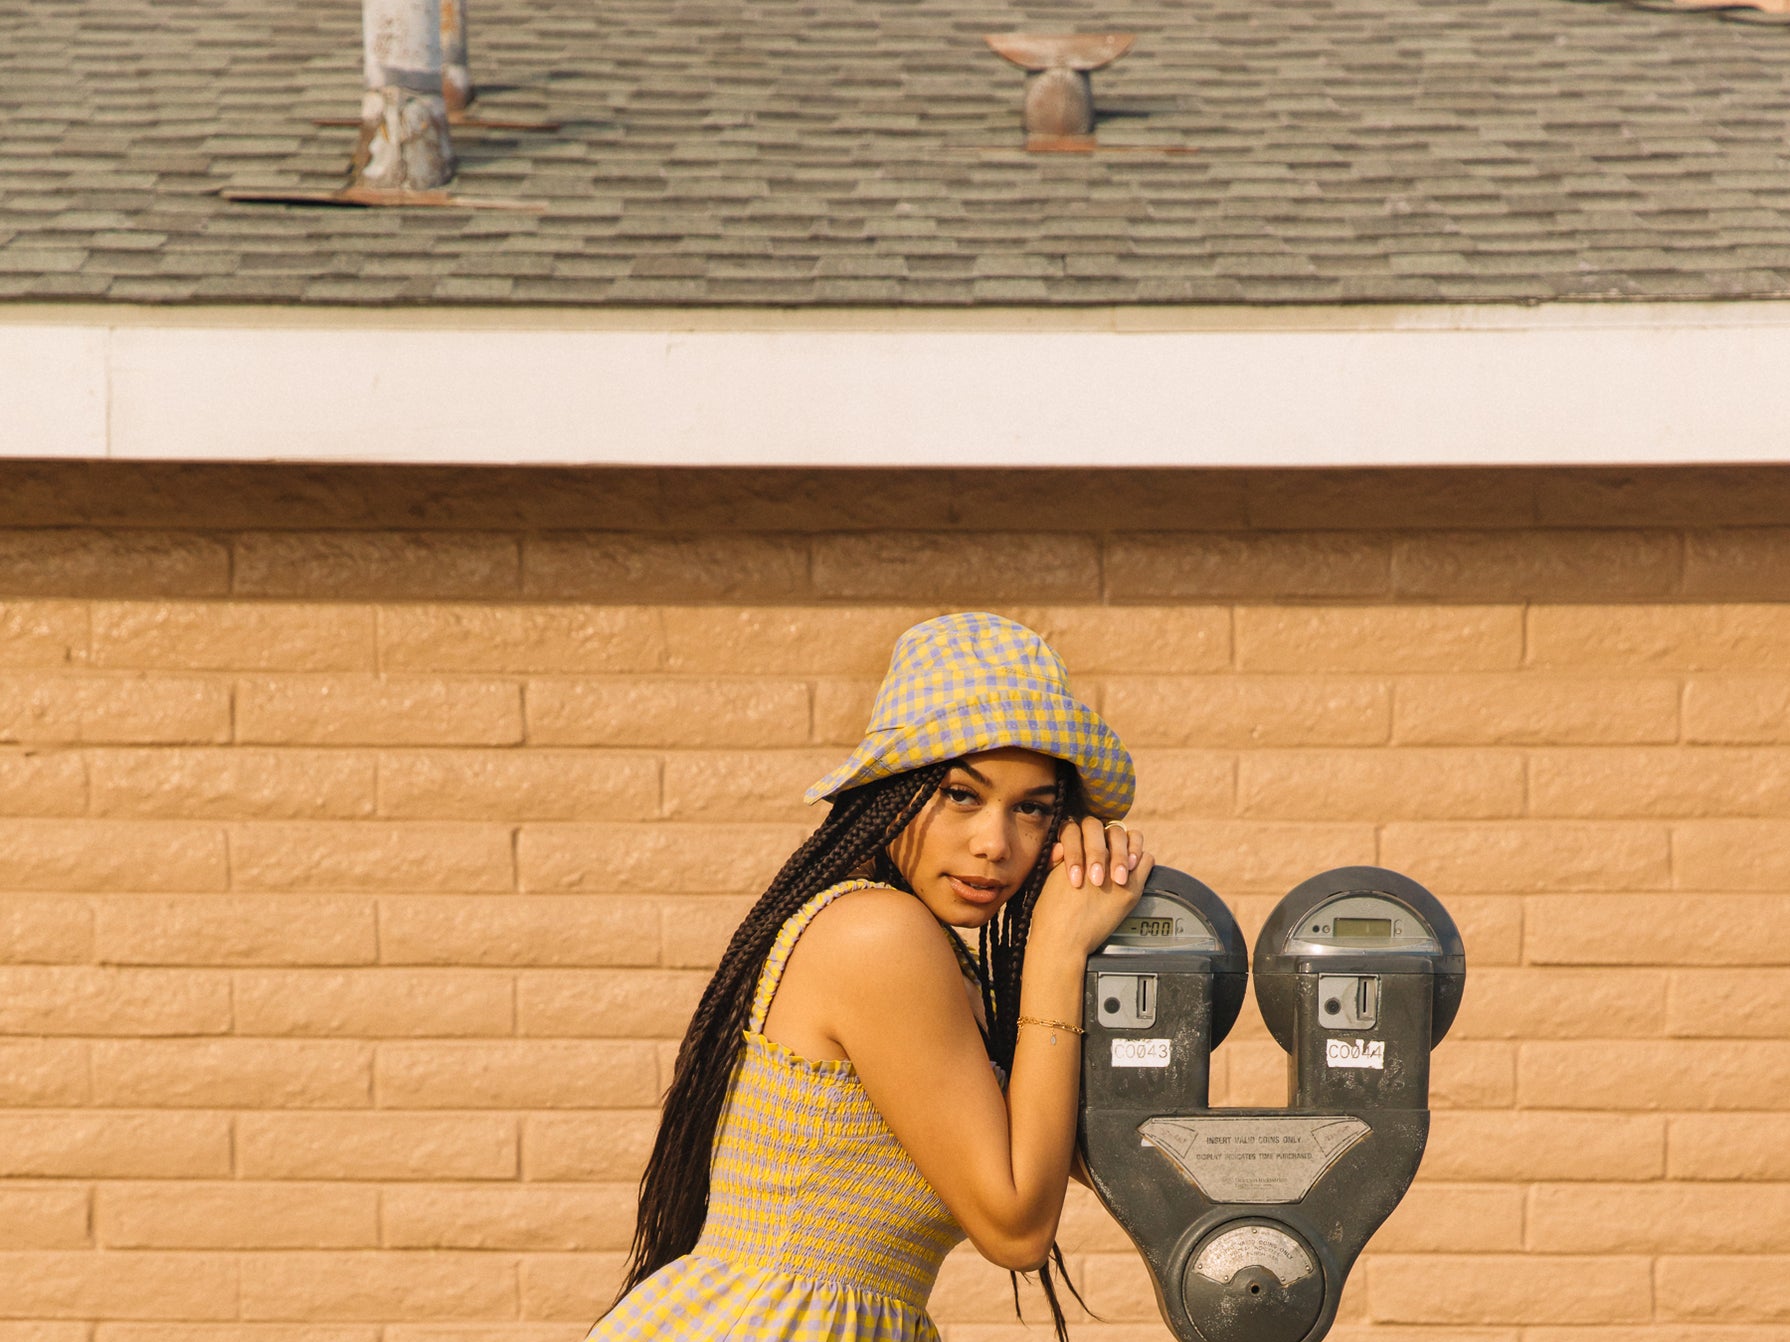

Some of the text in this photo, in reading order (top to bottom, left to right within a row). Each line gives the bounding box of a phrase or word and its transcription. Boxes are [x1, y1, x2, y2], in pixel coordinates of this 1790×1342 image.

[1131, 920, 1170, 936] -0:00
[1206, 1136, 1232, 1145] INSERT
[1234, 1136, 1256, 1145] VALID
[1258, 1136, 1280, 1144] COINS
